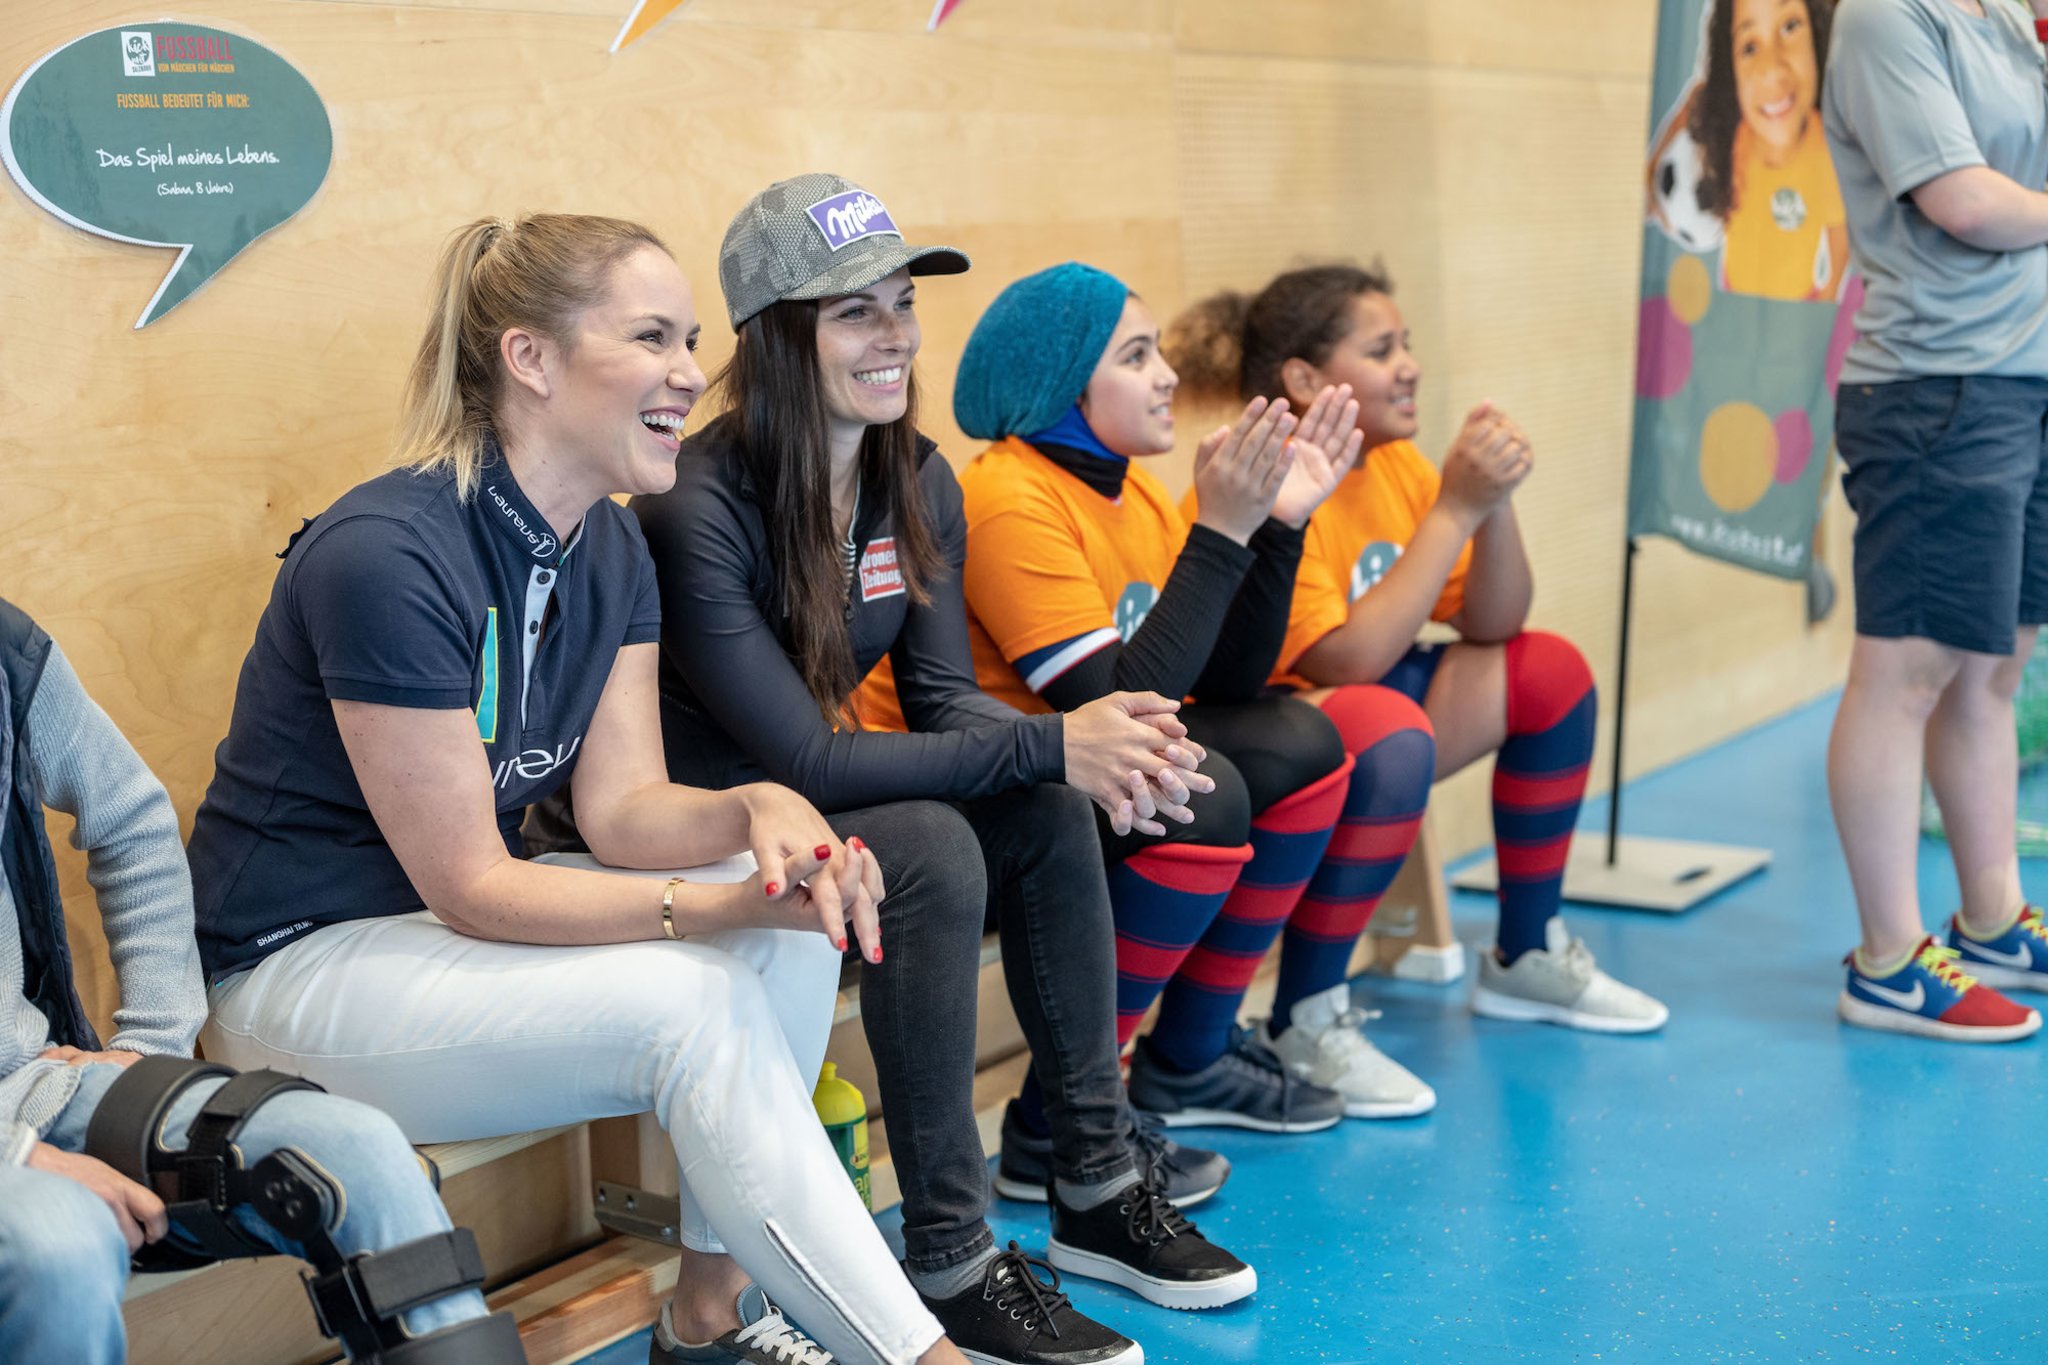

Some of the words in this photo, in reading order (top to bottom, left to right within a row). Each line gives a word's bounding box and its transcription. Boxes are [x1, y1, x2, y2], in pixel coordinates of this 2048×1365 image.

[156, 35, 234, 61] FUSSBALL
[158, 63, 169, 73] VON
[170, 62, 197, 73] MÄDCHEN
[198, 61, 209, 73] FÜR
[210, 62, 235, 73] MÄDCHEN
[117, 93, 160, 108] FUSSBALL
[163, 93, 205, 108] BEDEUTET
[207, 90, 224, 108] FÜR
[226, 93, 250, 108] MICH:
[95, 148, 133, 167] Das
[135, 142, 173, 173] Spiel
[177, 149, 224, 165] meines
[226, 143, 280, 165] Lebens.
[196, 181, 204, 194] 8
[205, 180, 234, 195] Jahre)
[863, 569, 901, 589] Zeitung
[256, 926, 295, 947] SHANGHAI
